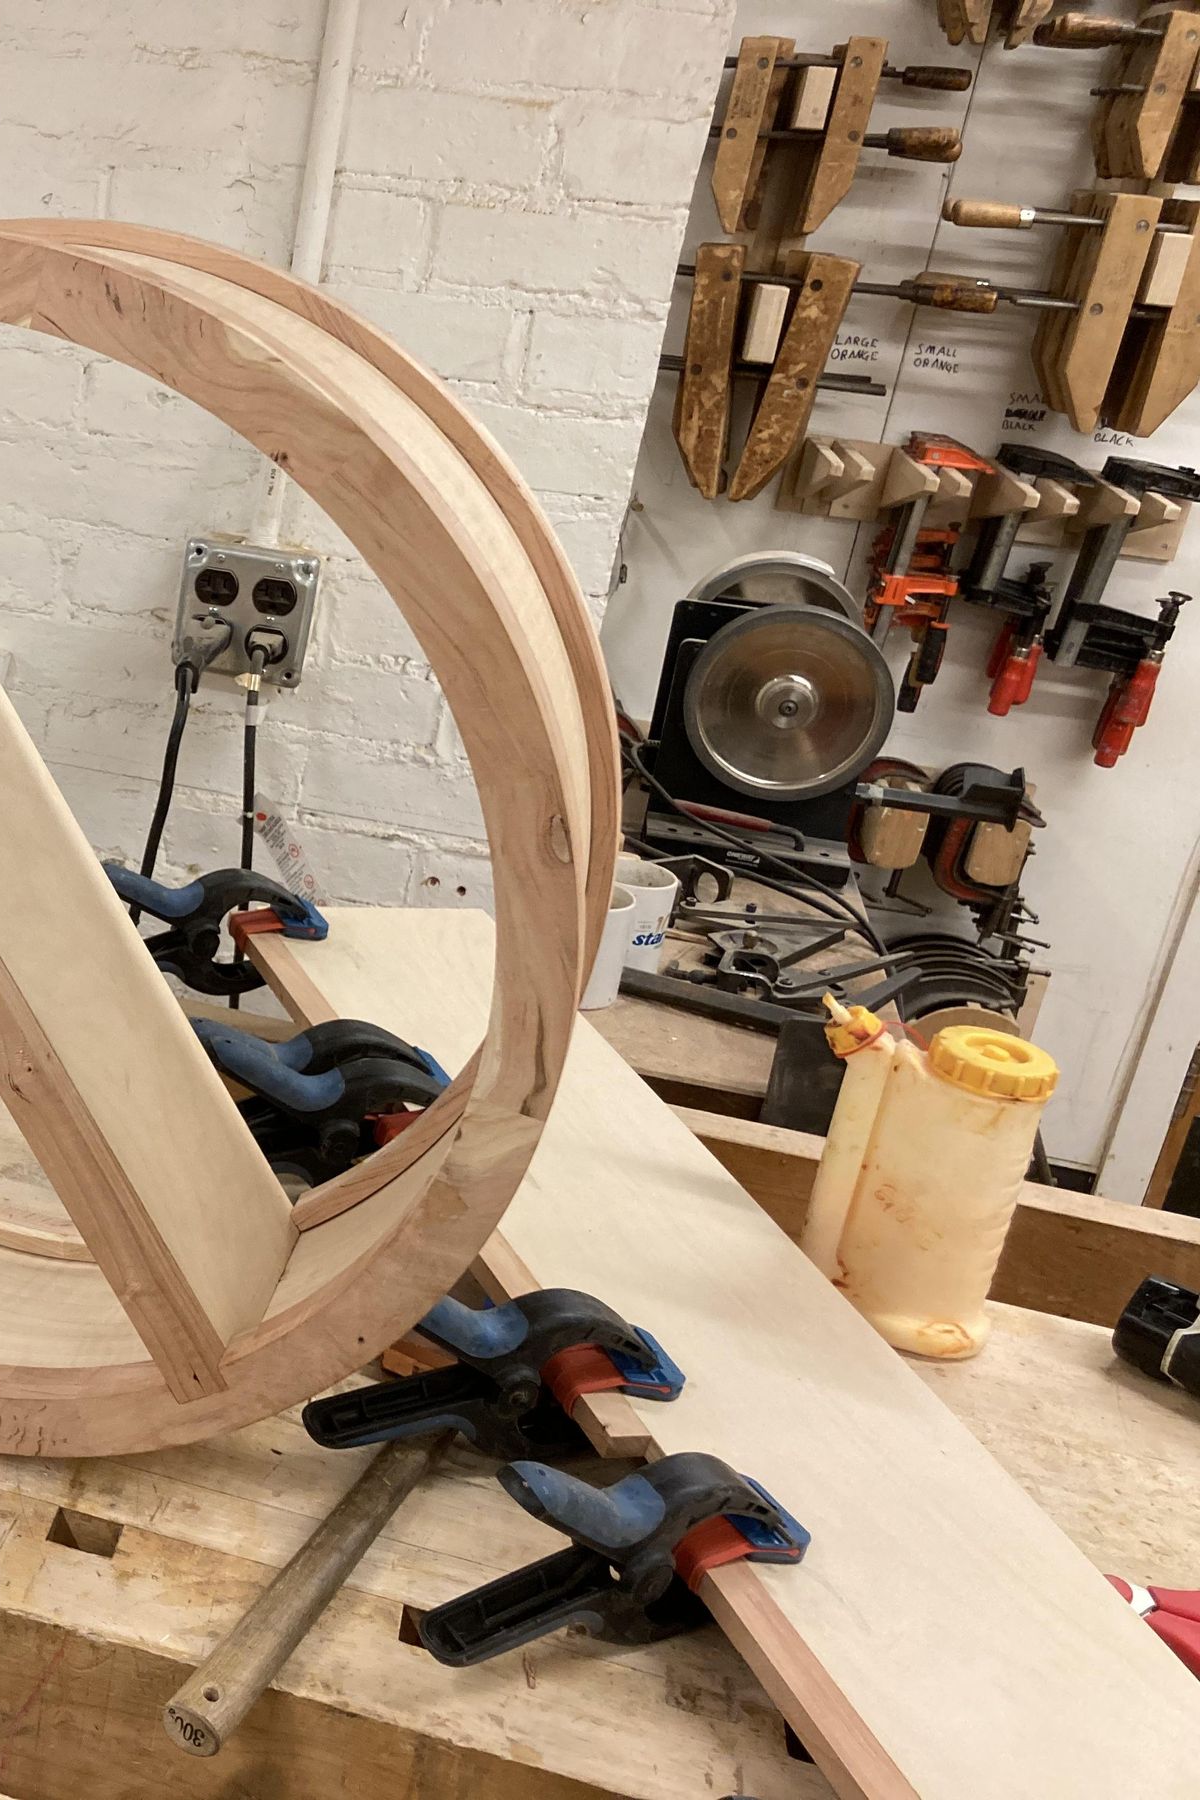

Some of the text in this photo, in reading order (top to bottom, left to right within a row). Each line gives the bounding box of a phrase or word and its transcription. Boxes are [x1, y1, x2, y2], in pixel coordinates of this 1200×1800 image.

[834, 334, 879, 348] LARGE
[830, 348, 879, 361] ORANGE
[914, 342, 957, 358] SMALL
[913, 357, 960, 374] ORANGE
[1008, 391, 1044, 405] SMA
[1001, 420, 1038, 431] BLACK
[1093, 432, 1134, 447] BLACK
